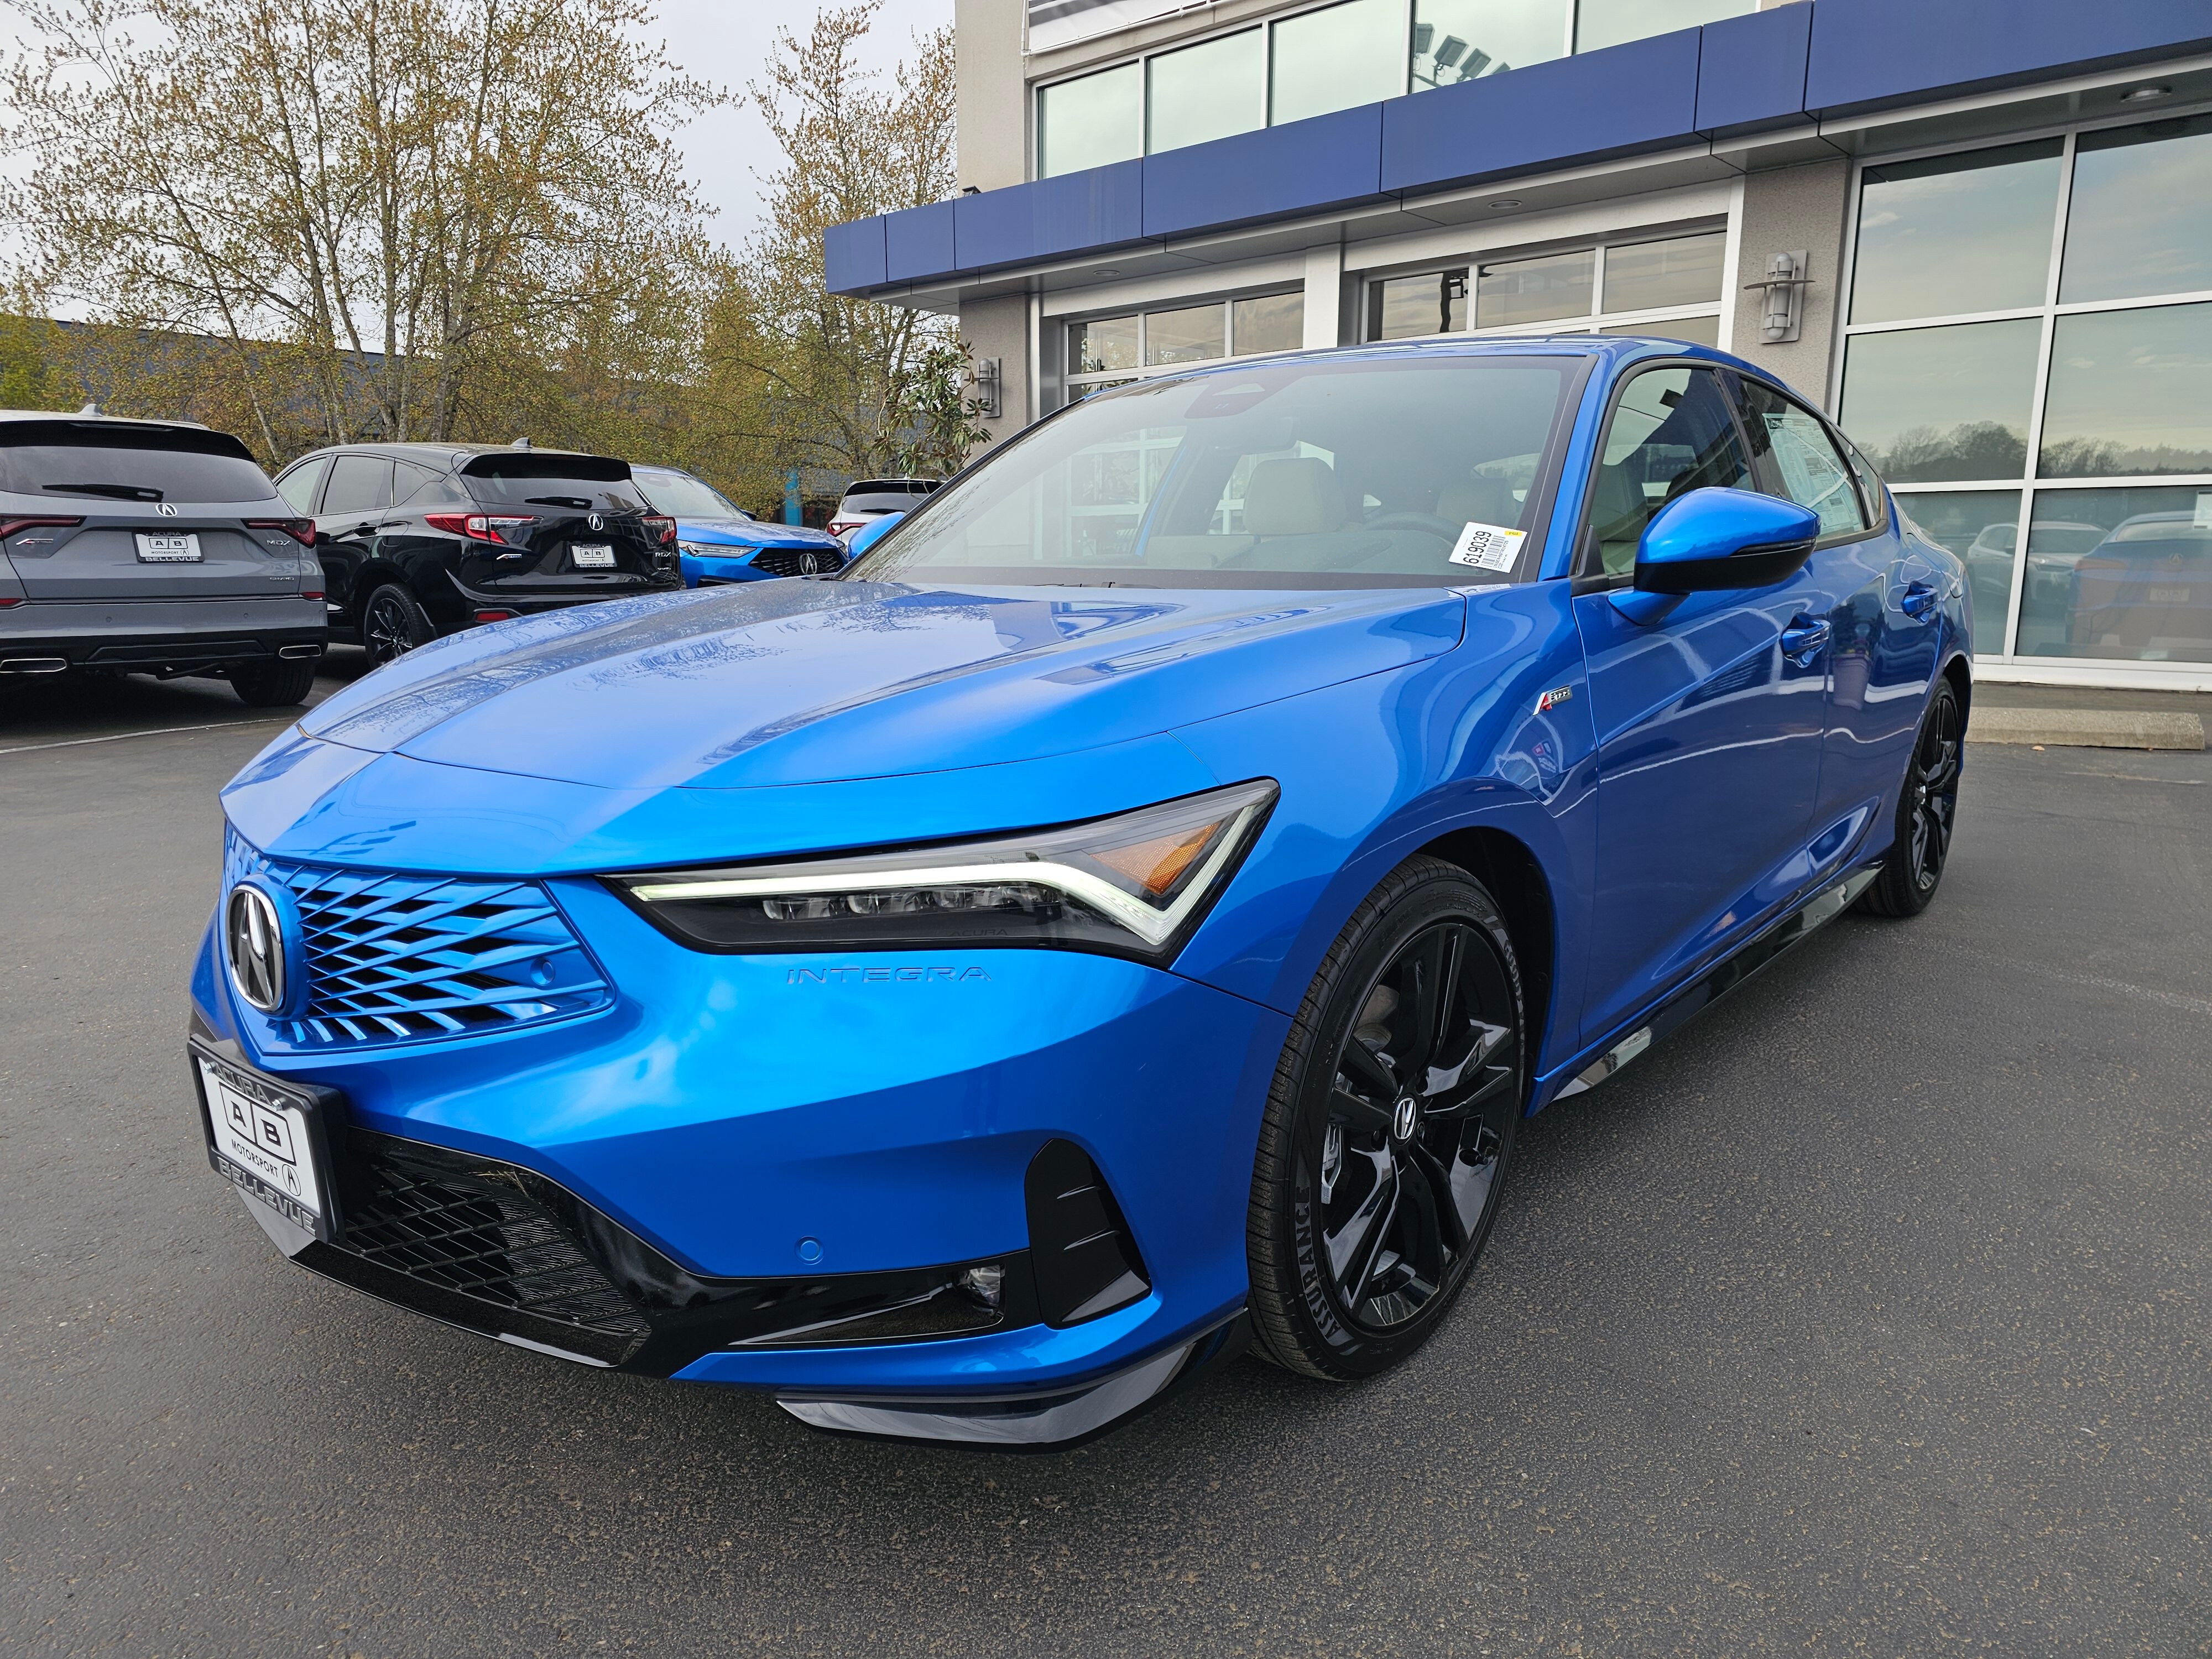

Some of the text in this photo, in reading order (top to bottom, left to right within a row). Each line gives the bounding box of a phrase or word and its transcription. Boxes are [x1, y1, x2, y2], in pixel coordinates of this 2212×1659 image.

[1463, 530, 1492, 564] 619039
[786, 966, 993, 985] INTEGRA
[216, 1062, 272, 1105] ACURA
[230, 1100, 282, 1147] A B
[231, 1138, 279, 1178] MOTORSPORT
[217, 1156, 317, 1237] BELLEVUE
[1296, 1186, 1342, 1339] ASSURANCE
